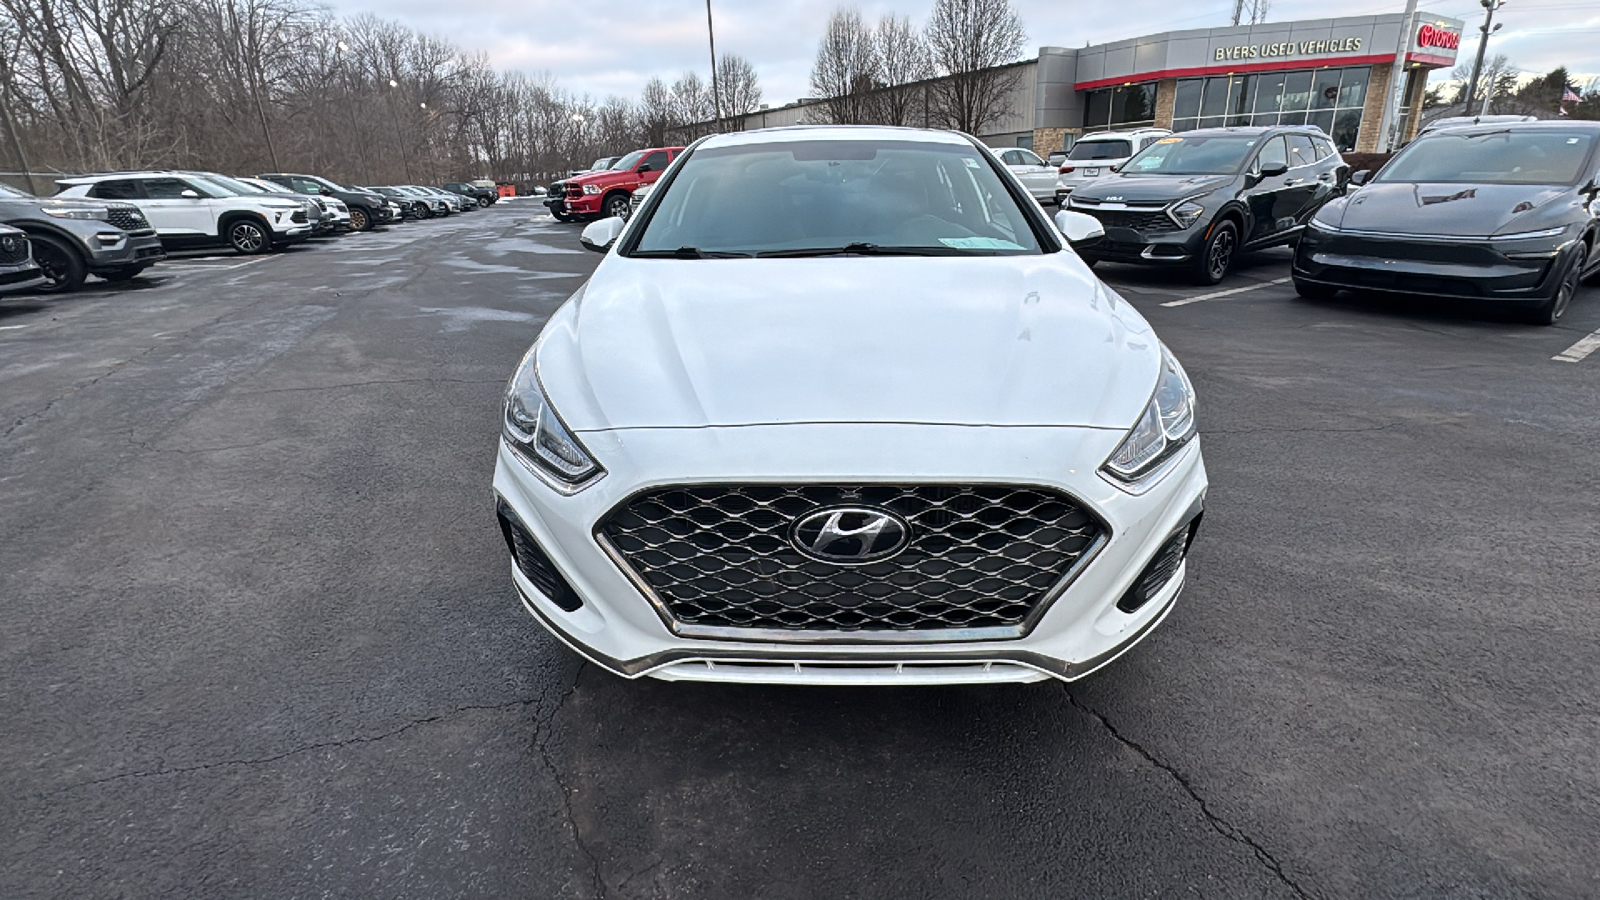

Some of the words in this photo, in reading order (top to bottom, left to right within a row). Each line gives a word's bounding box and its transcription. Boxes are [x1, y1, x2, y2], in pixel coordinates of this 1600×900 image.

[1215, 45, 1258, 60] BYERS
[1260, 42, 1296, 57] USED
[1299, 37, 1362, 54] VEHICLES
[1432, 29, 1459, 49] TOYOTA
